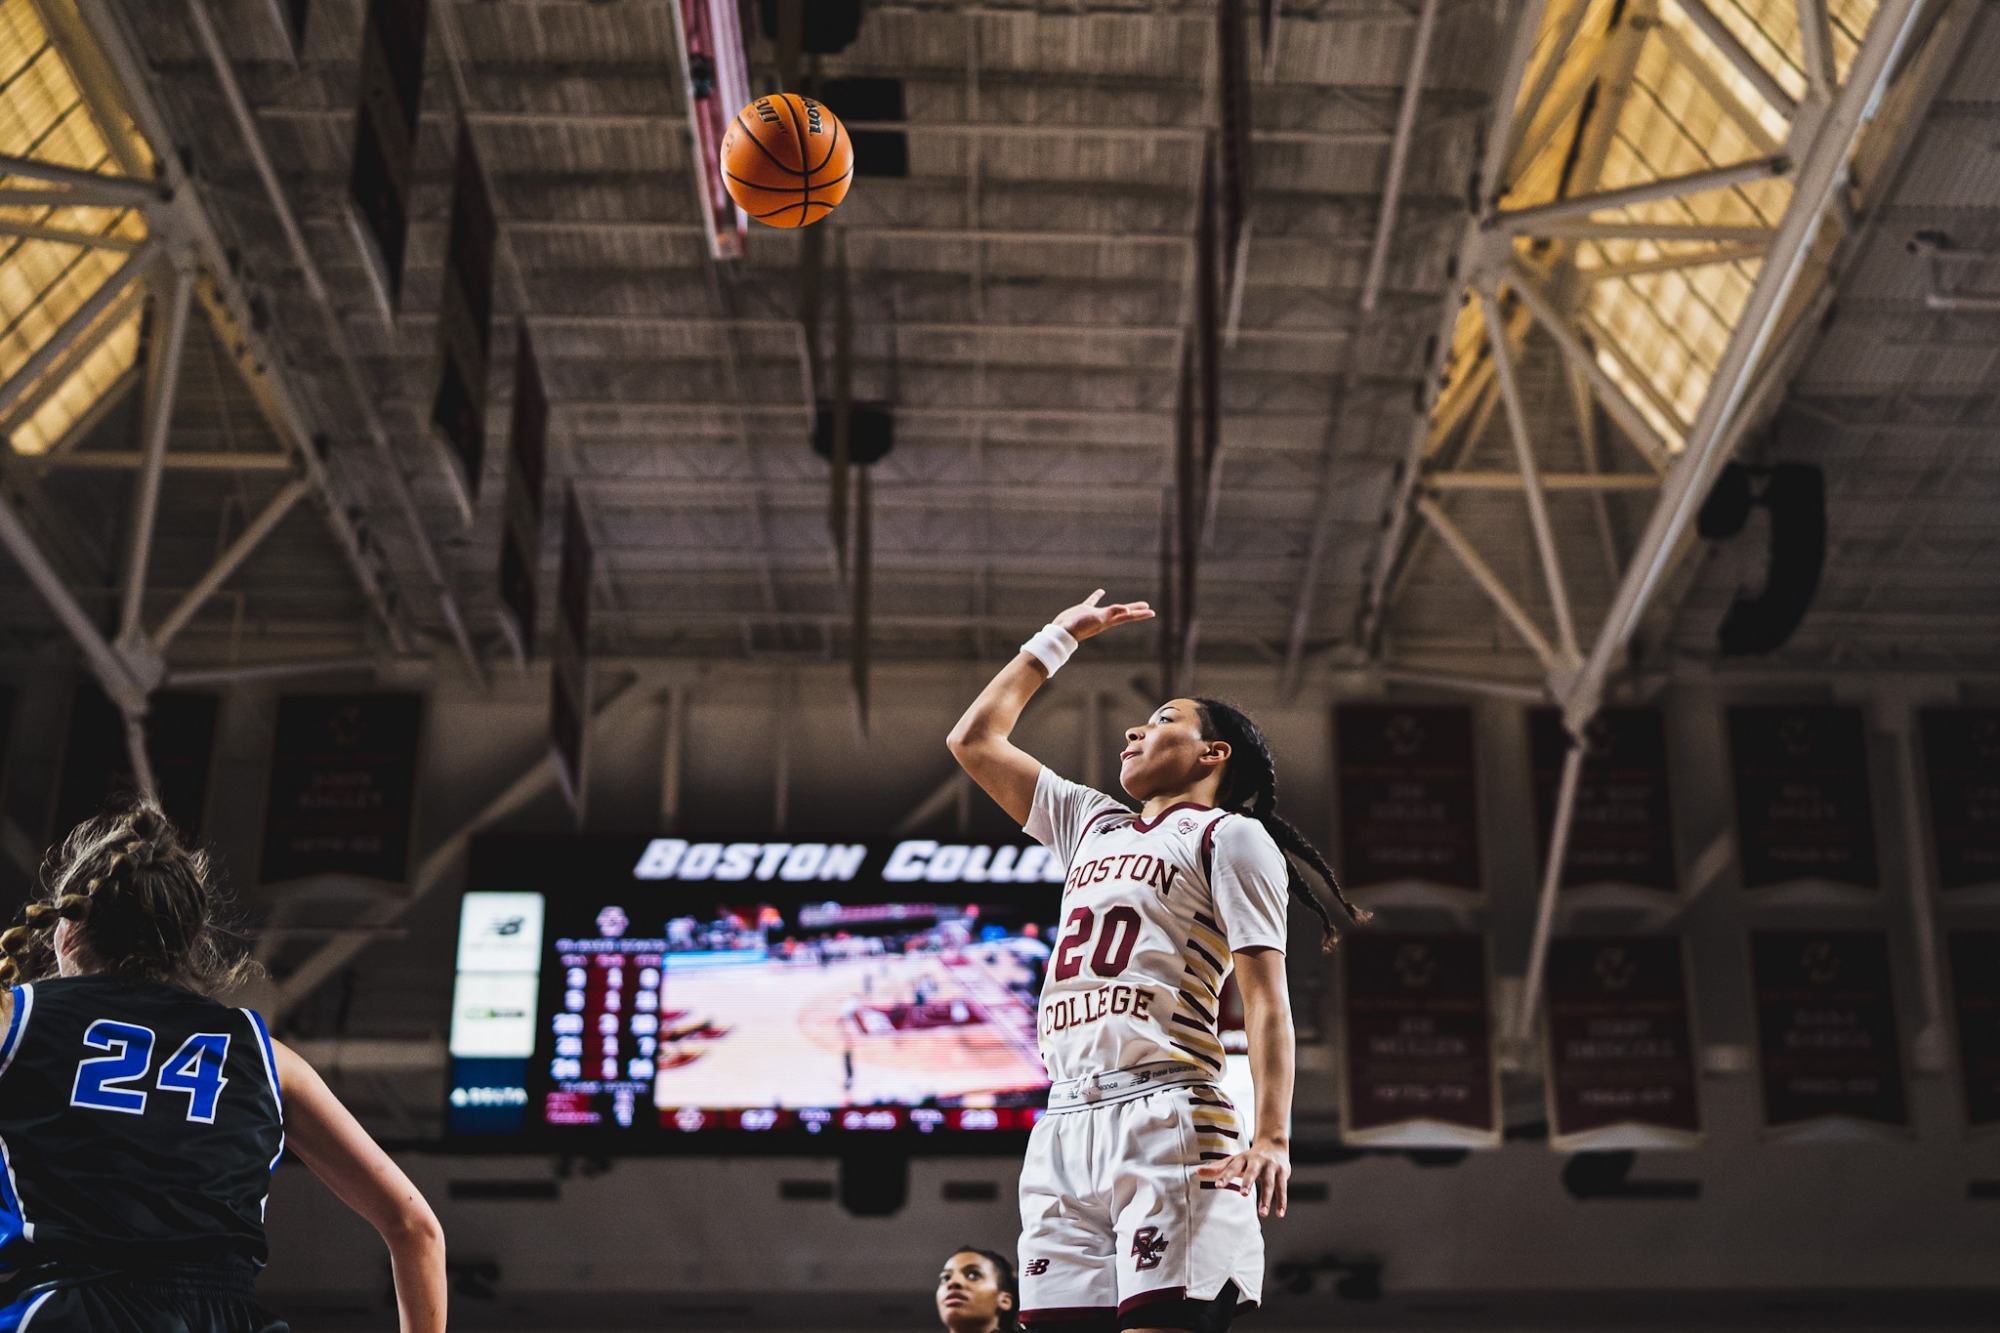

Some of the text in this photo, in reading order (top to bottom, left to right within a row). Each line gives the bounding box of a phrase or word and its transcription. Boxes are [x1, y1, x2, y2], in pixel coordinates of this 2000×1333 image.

[634, 839, 1067, 883] BOSTON COLLE
[1065, 854, 1180, 897] BOSTON
[1055, 905, 1142, 982] 20
[1046, 985, 1155, 1035] COLLEGE
[70, 1018, 231, 1124] 24
